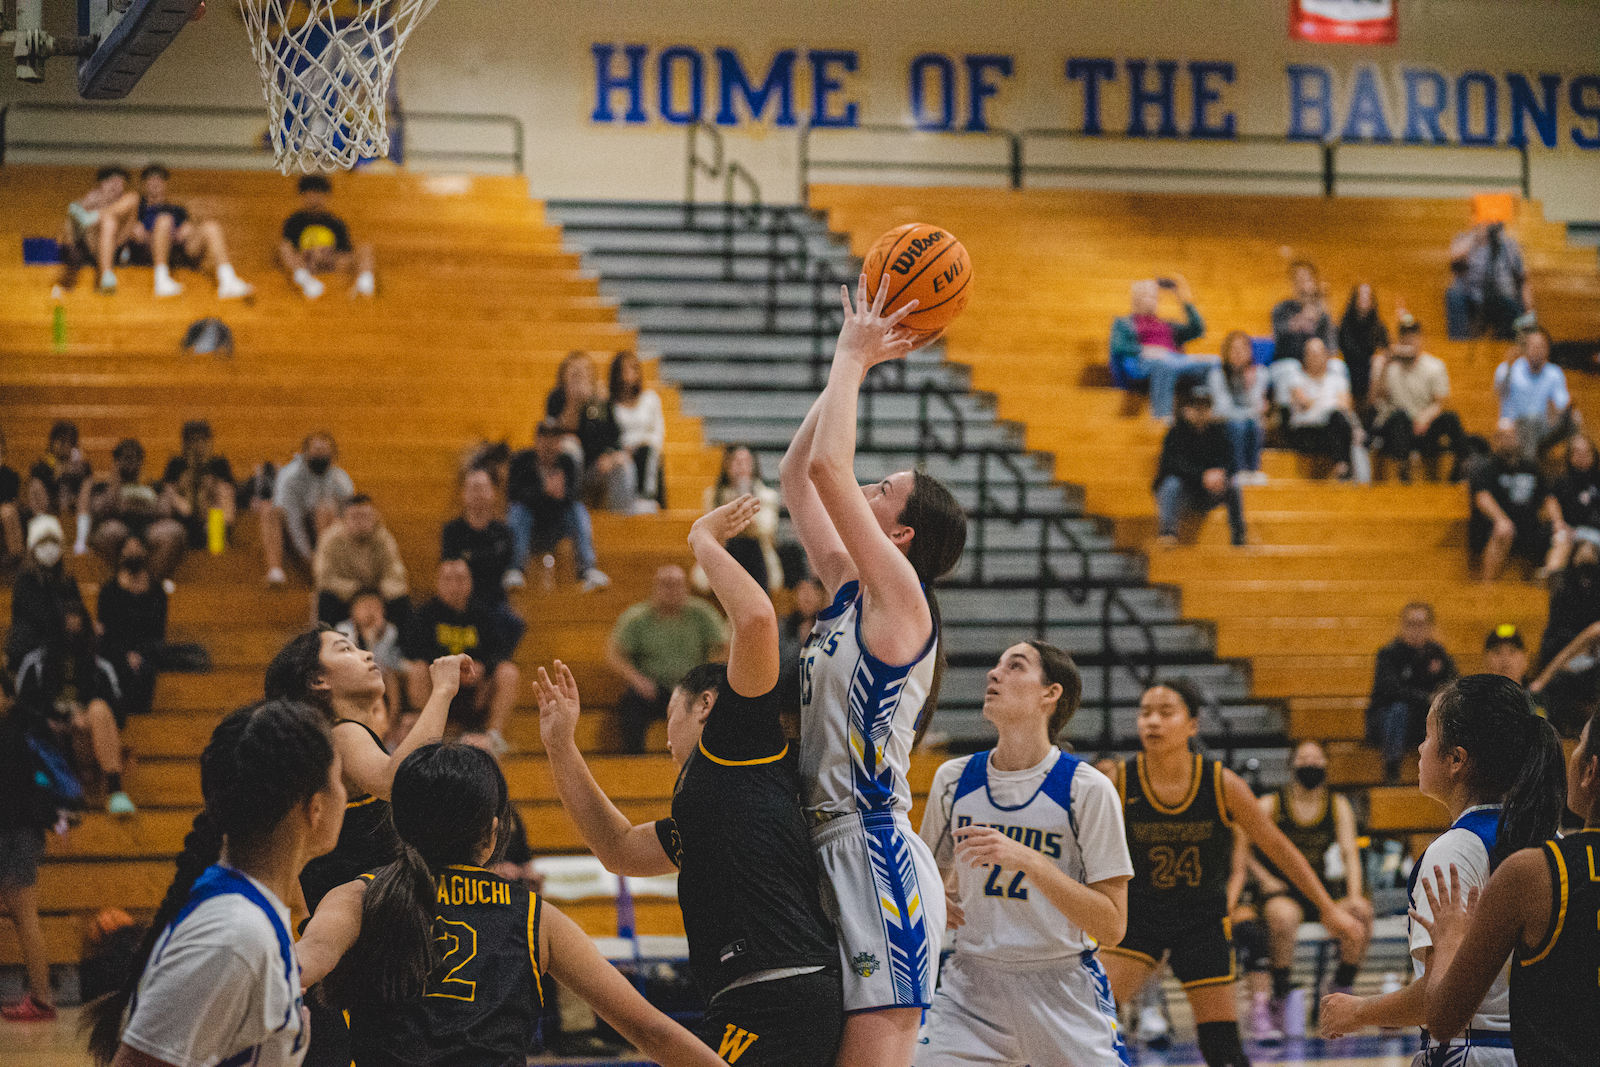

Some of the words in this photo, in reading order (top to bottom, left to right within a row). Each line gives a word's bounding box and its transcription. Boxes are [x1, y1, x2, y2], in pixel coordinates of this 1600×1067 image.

[590, 42, 859, 128] HOME
[910, 52, 1015, 133] OF
[1065, 57, 1236, 139] THE
[1286, 64, 1600, 149] BARONS
[890, 231, 945, 275] Wilson
[957, 815, 1063, 859] BONS
[982, 863, 1029, 900] 22
[1148, 845, 1202, 889] 24
[431, 874, 511, 905] AGUCHI
[422, 915, 477, 1002] 2
[718, 1023, 759, 1065] W
